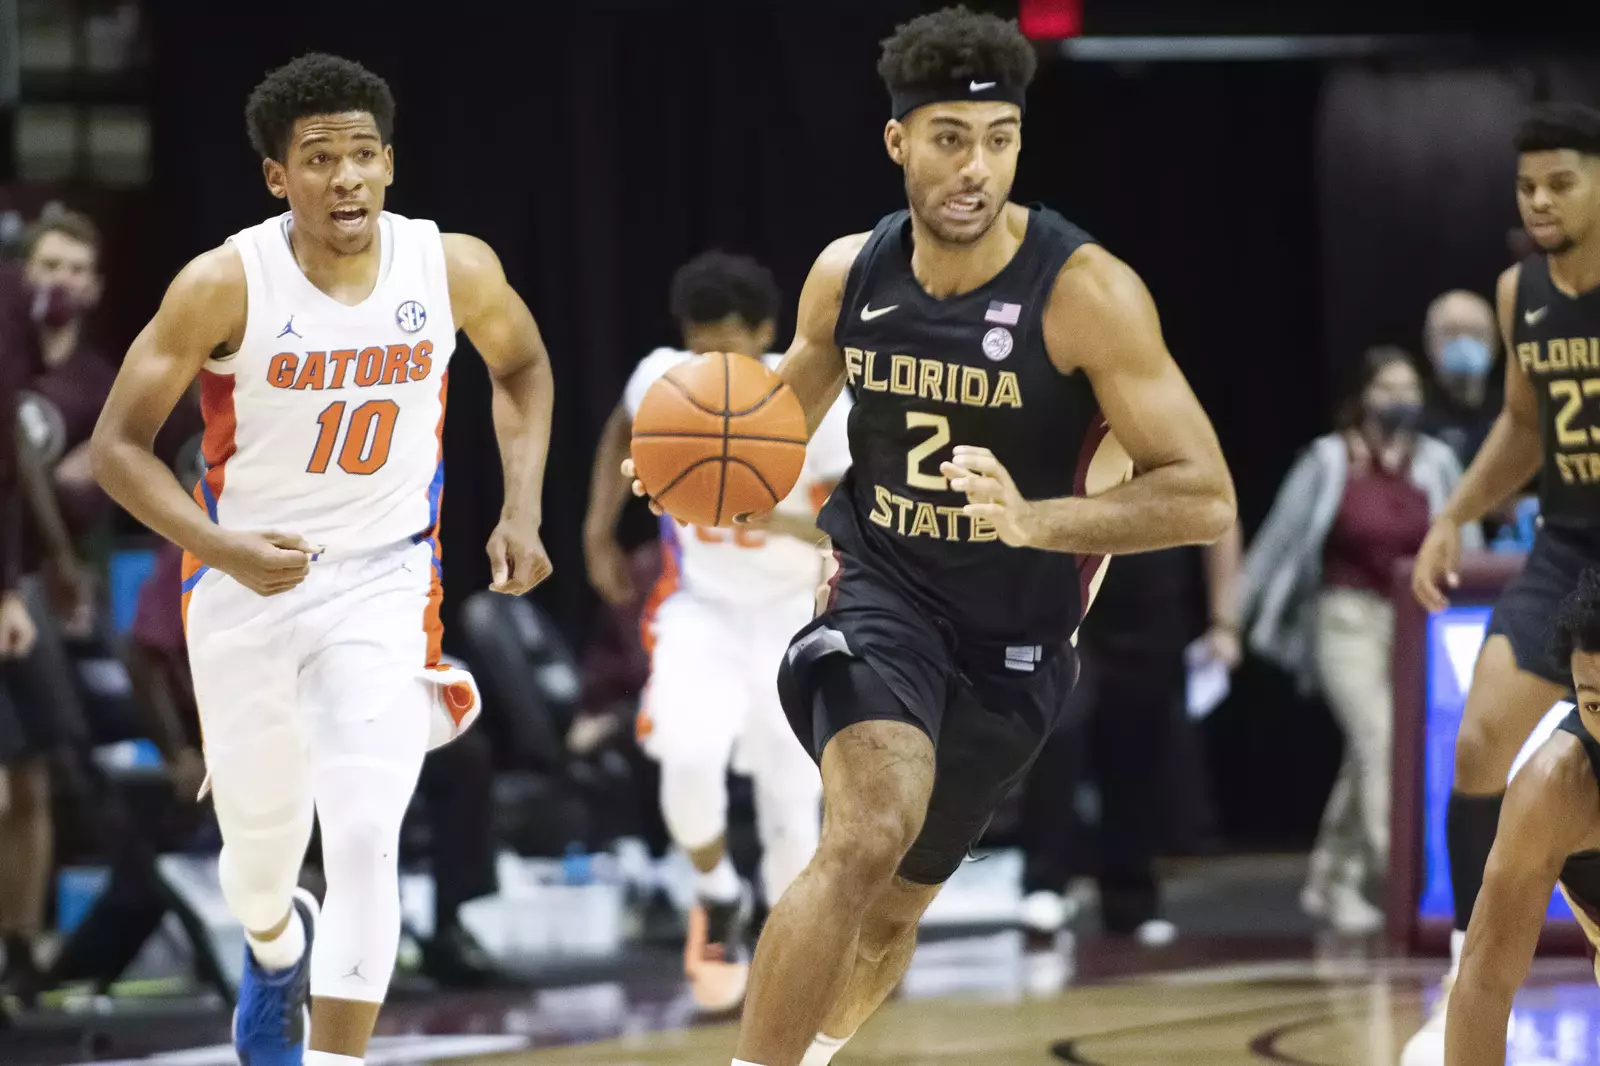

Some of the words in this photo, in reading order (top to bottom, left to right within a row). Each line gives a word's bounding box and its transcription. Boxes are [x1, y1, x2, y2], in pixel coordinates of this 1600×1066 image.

[397, 301, 426, 332] SEC
[266, 340, 434, 391] GATORS
[844, 346, 1023, 409] FLORIDA
[305, 399, 400, 476] 10
[905, 411, 950, 491] 2
